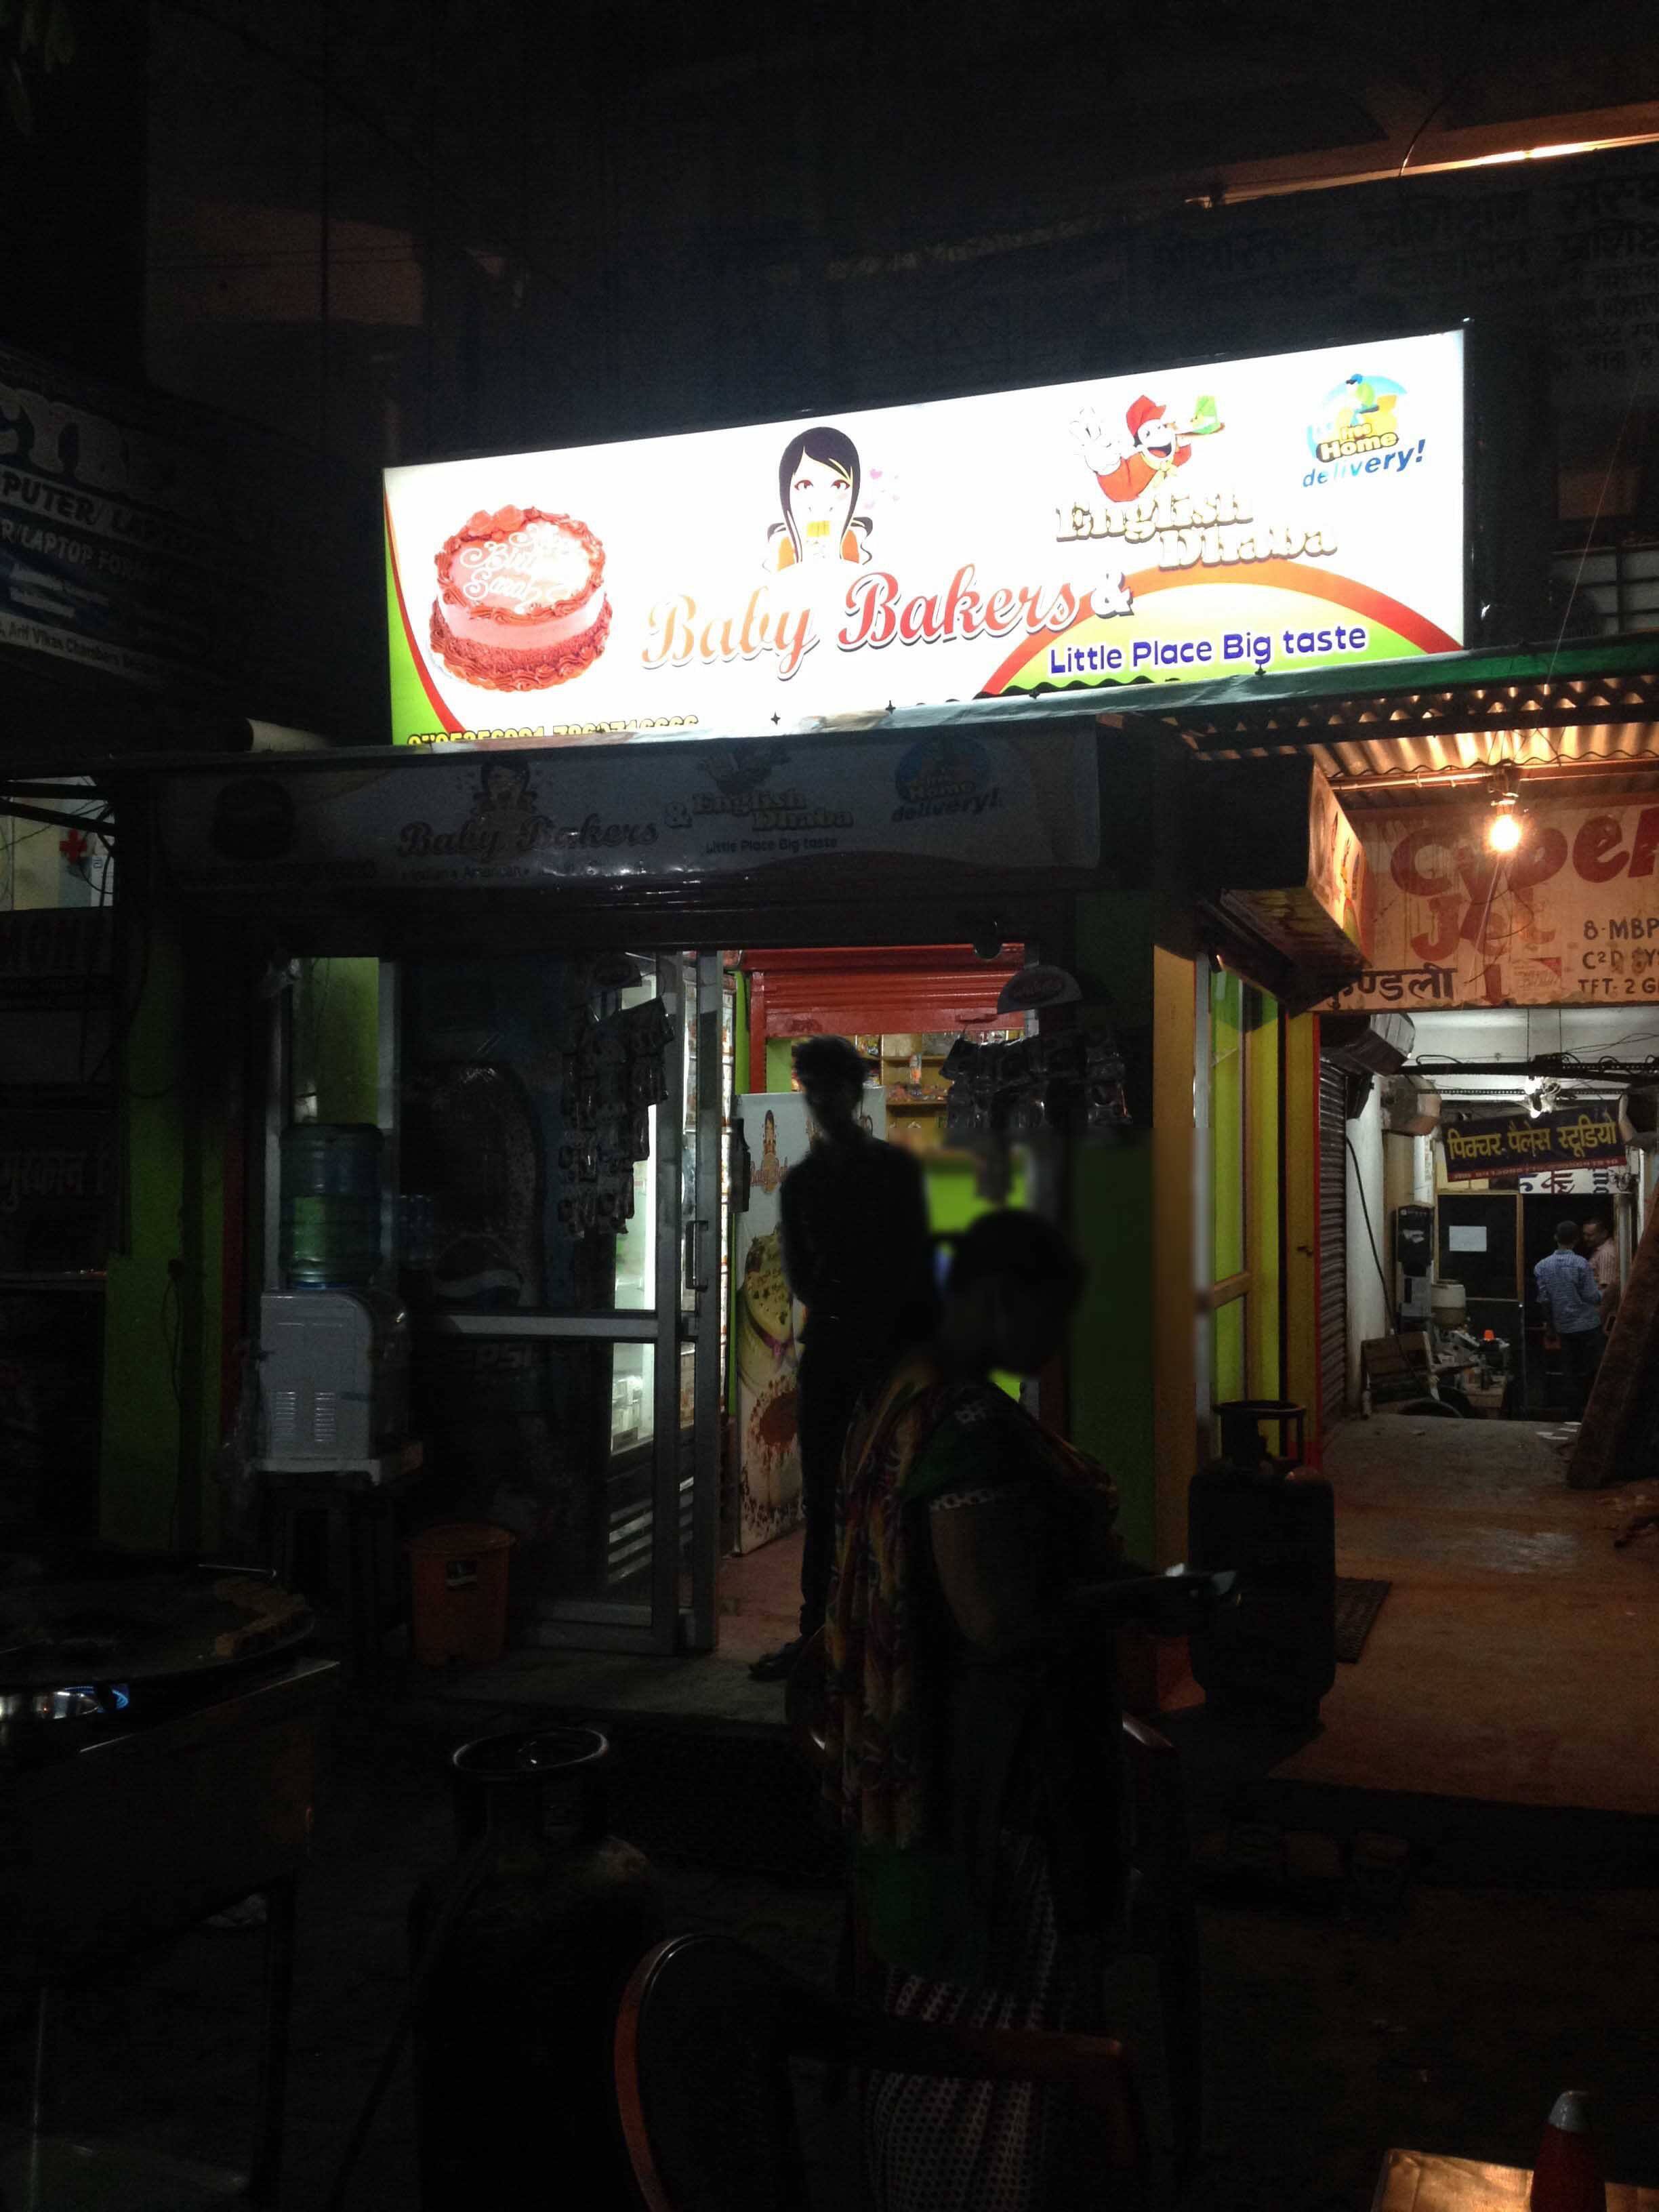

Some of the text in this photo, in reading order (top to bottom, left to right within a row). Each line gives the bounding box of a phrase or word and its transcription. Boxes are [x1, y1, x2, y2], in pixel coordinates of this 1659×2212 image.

[1302, 438, 1427, 488] delivery!
[1317, 432, 1399, 464] Home
[1054, 489, 1254, 544] English
[1158, 523, 1338, 571] Dhaba
[640, 586, 820, 682] Baby
[836, 564, 1081, 651] Bakers
[1090, 571, 1134, 618] &
[1050, 624, 1367, 674] Little Place Big taste
